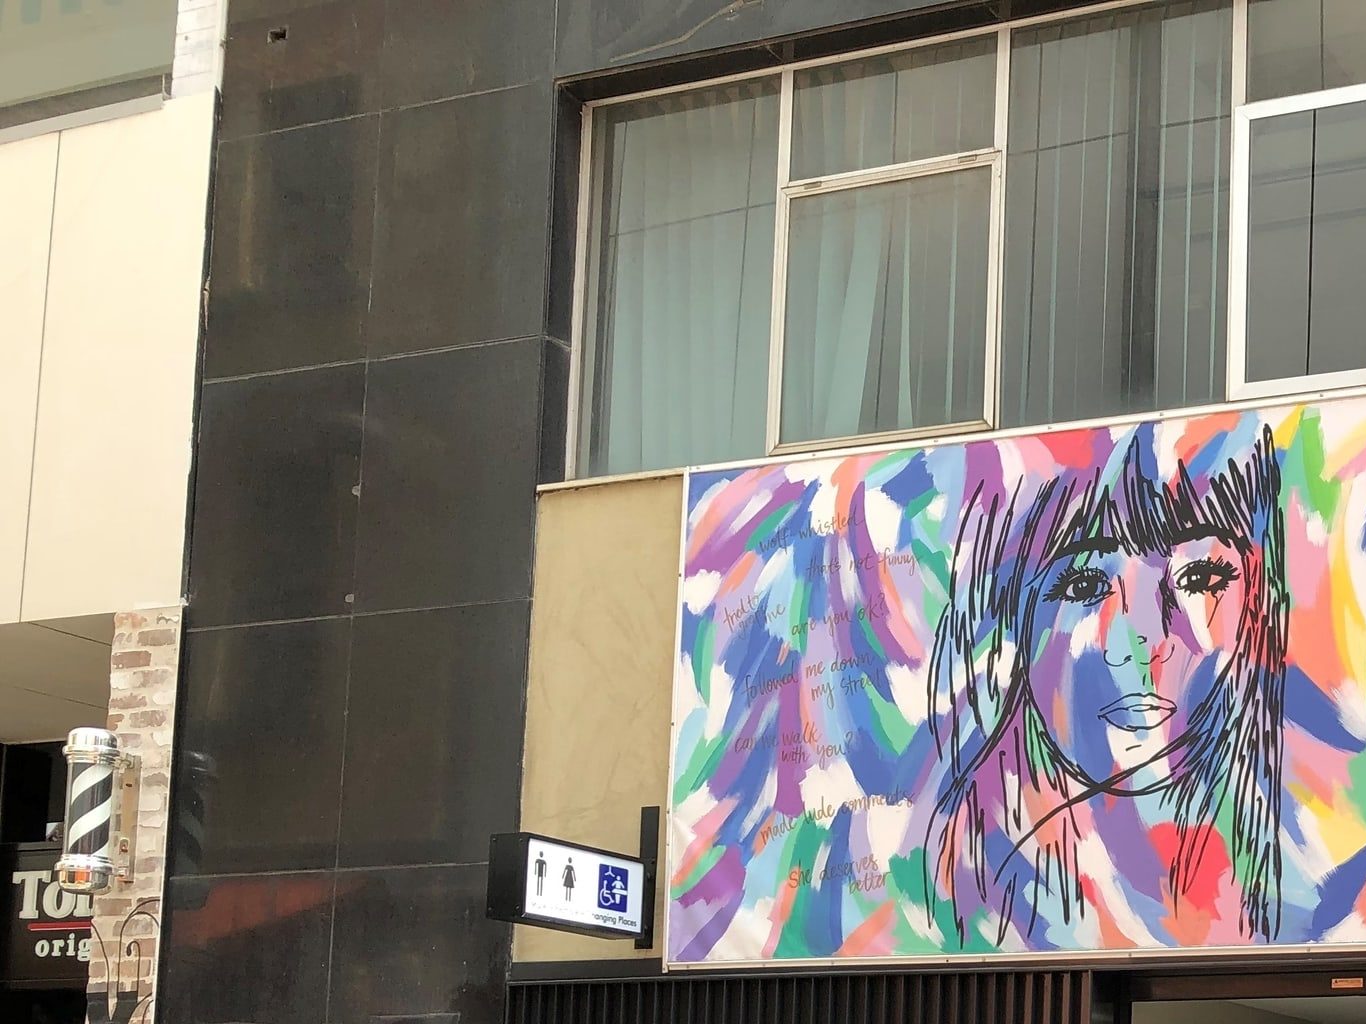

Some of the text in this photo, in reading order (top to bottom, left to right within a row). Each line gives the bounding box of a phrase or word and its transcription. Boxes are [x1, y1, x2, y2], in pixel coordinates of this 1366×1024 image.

[798, 508, 864, 540] whistled
[849, 552, 875, 573] not
[878, 546, 921, 577] funny
[791, 592, 888, 637] are you ok?
[742, 652, 874, 708] followed me down
[810, 681, 835, 710] my
[782, 721, 821, 746] walk
[780, 731, 854, 771] with you?
[760, 784, 916, 845] made lude comments
[819, 853, 879, 882] deserves
[849, 871, 894, 894] better
[592, 913, 637, 927] anging Places
[35, 933, 90, 961] orig
